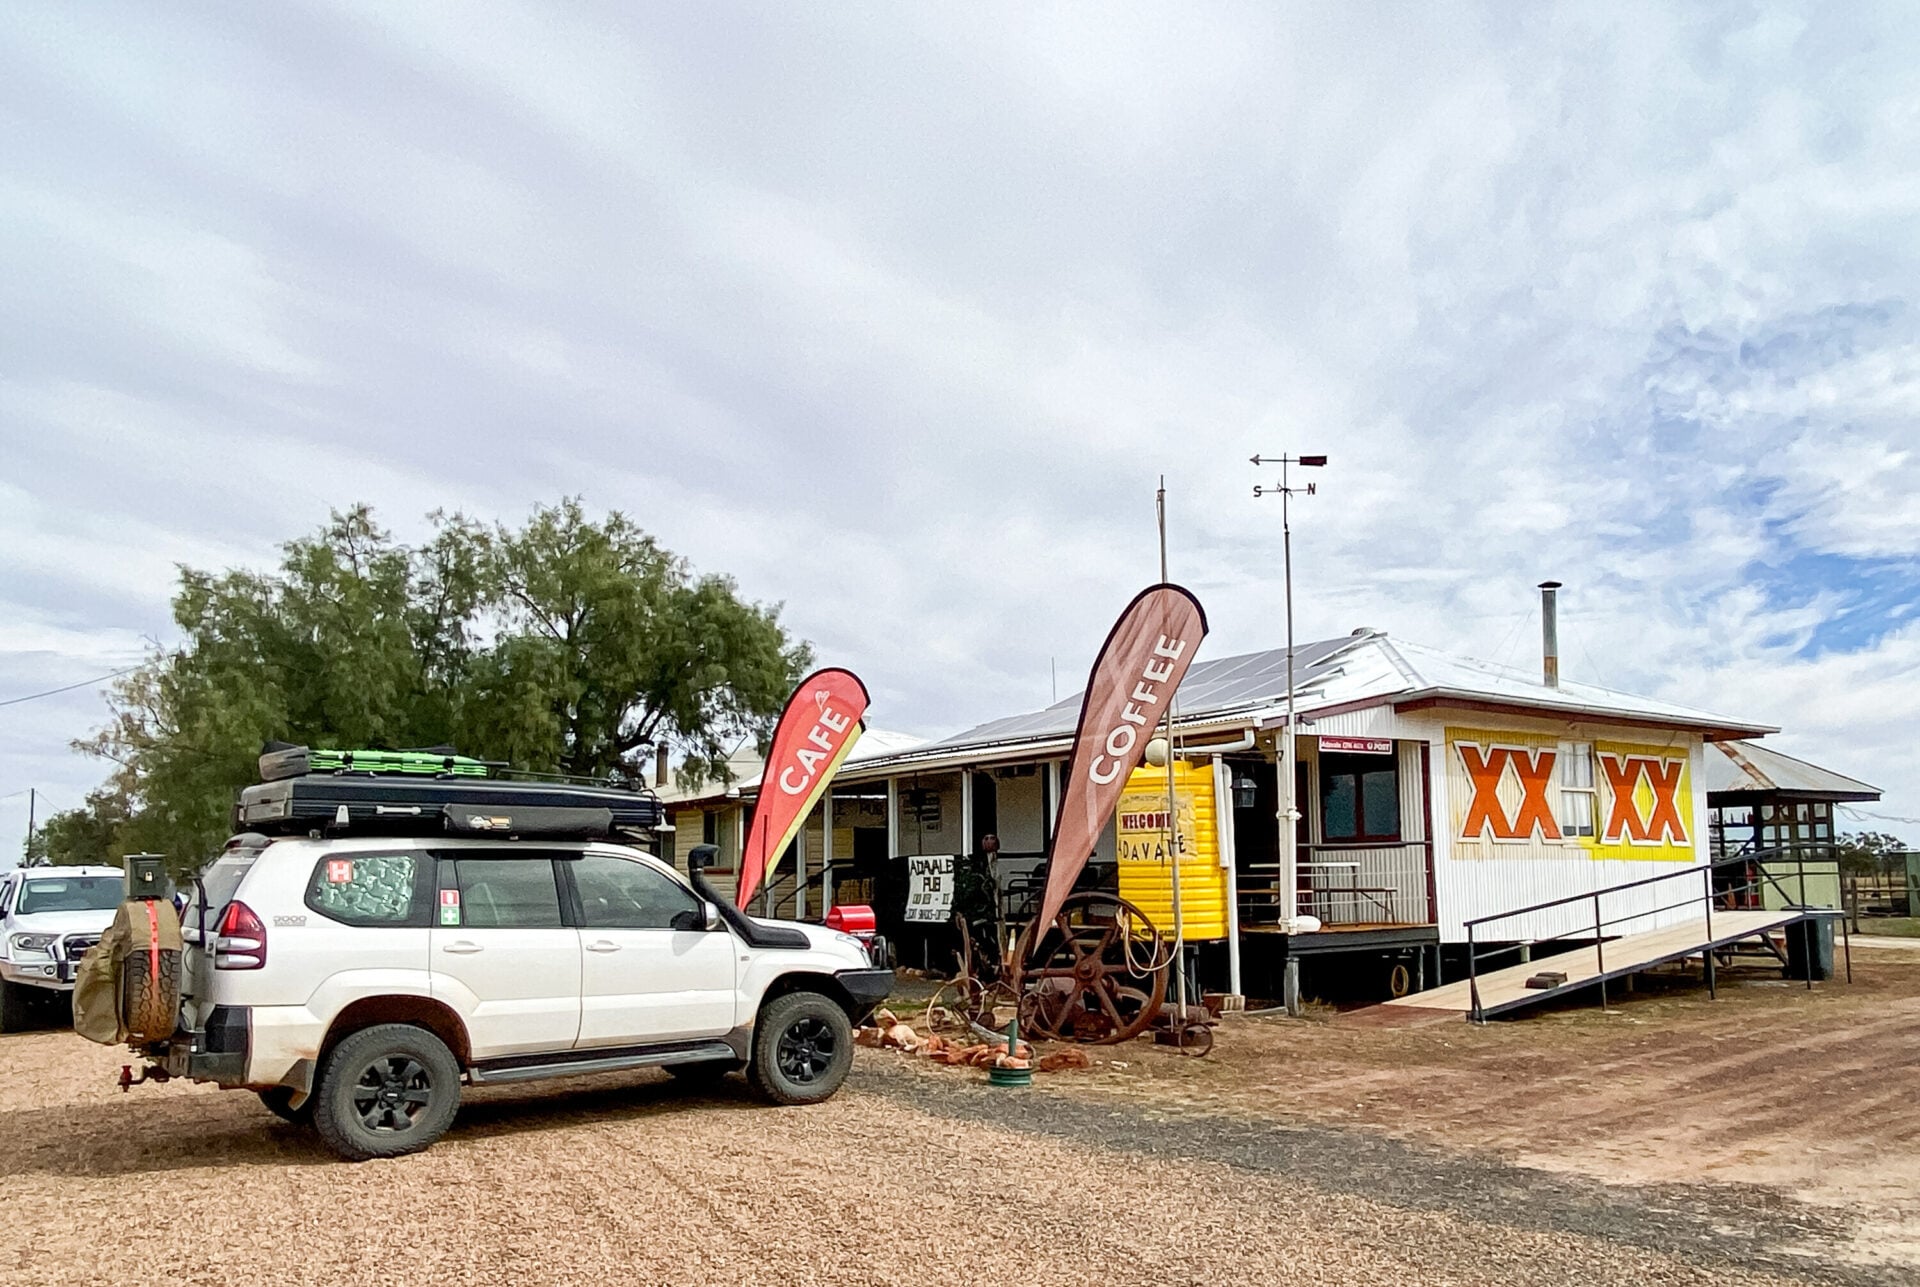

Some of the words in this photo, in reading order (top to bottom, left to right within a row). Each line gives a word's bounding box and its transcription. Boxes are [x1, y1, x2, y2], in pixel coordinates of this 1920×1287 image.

[1253, 485, 1262, 498] S
[1307, 482, 1316, 496] N
[1089, 634, 1187, 785] COFFEE
[779, 707, 851, 795] CAFE
[922, 876, 941, 892] PUB
